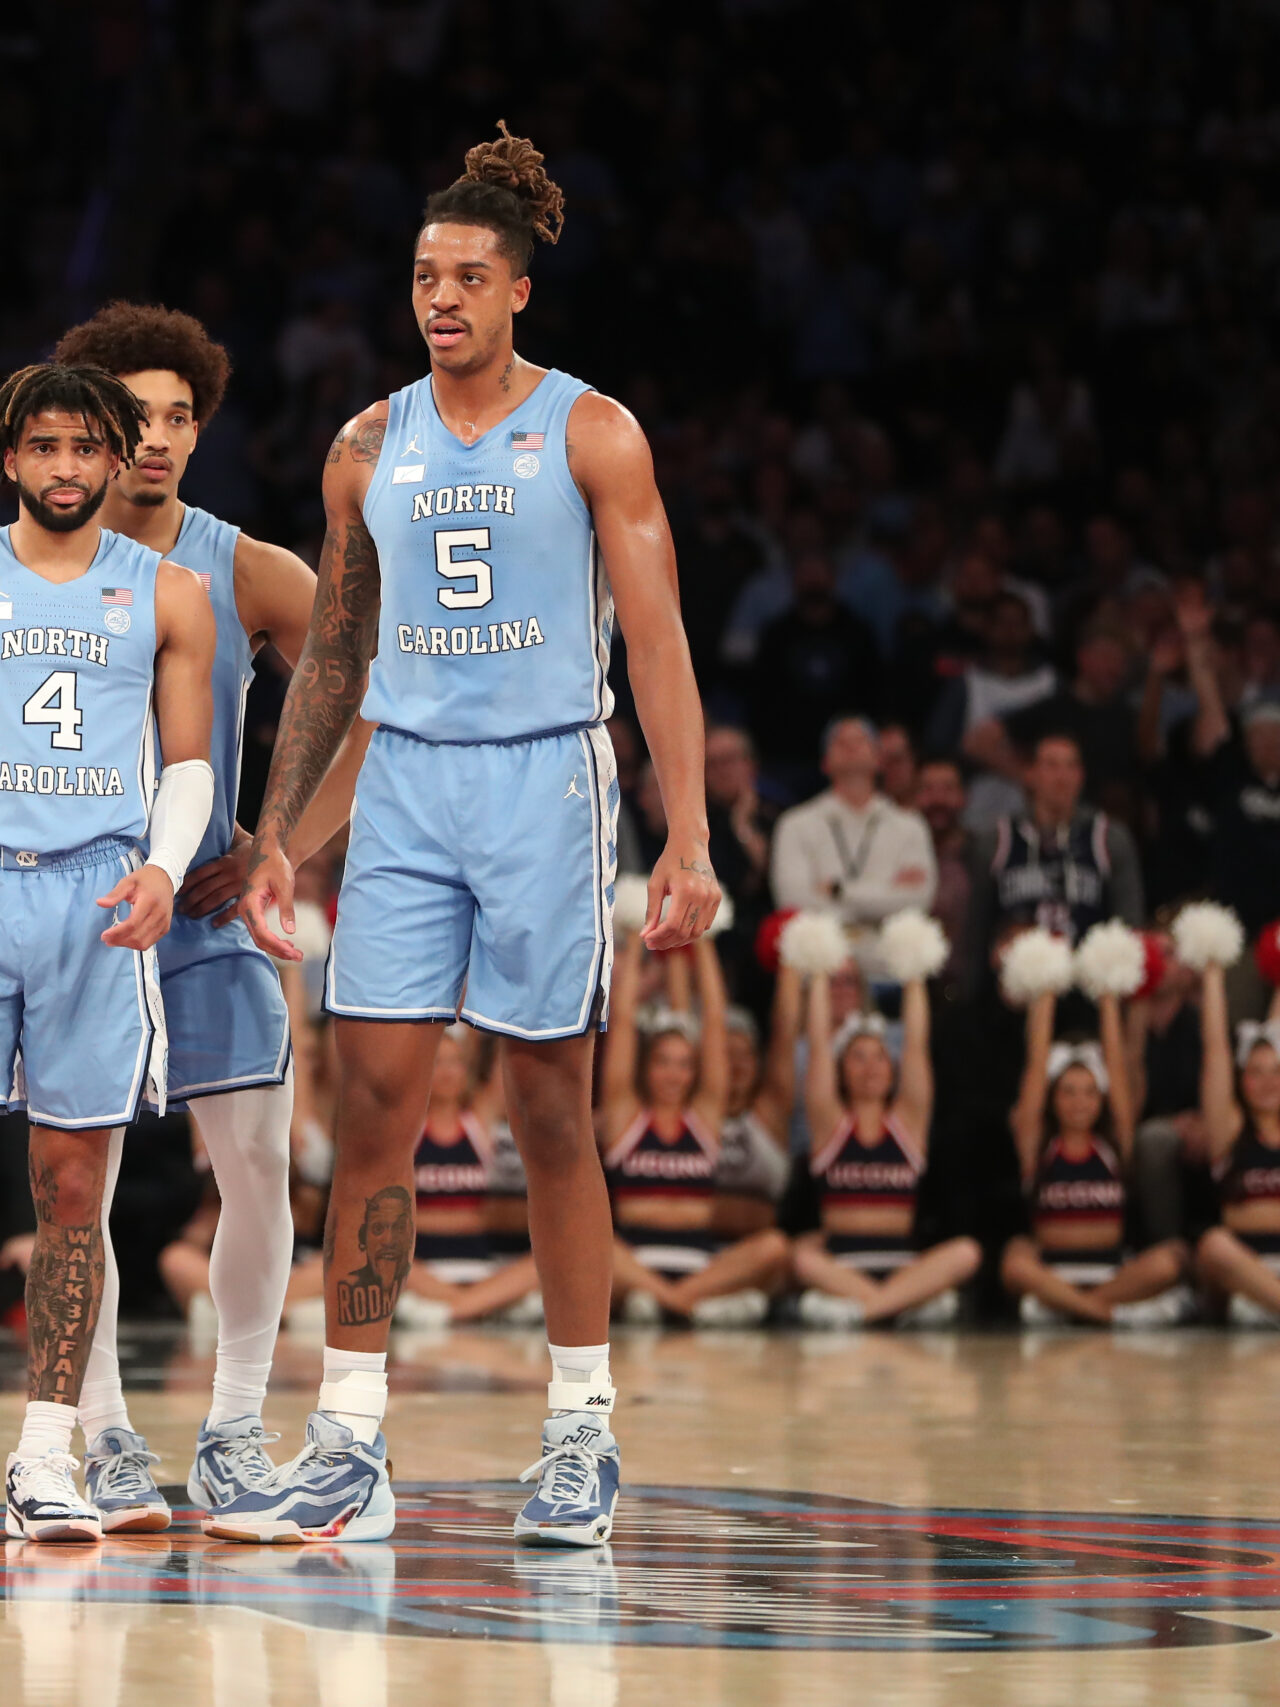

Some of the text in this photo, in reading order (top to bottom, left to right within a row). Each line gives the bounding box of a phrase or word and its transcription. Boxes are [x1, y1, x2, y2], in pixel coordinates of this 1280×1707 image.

[411, 484, 515, 522] NORTH
[434, 527, 494, 610] 5
[1, 627, 109, 667] NORTH
[397, 616, 544, 656] CAROLINA
[23, 670, 83, 751] 4
[48, 1340, 77, 1405] FAIT
